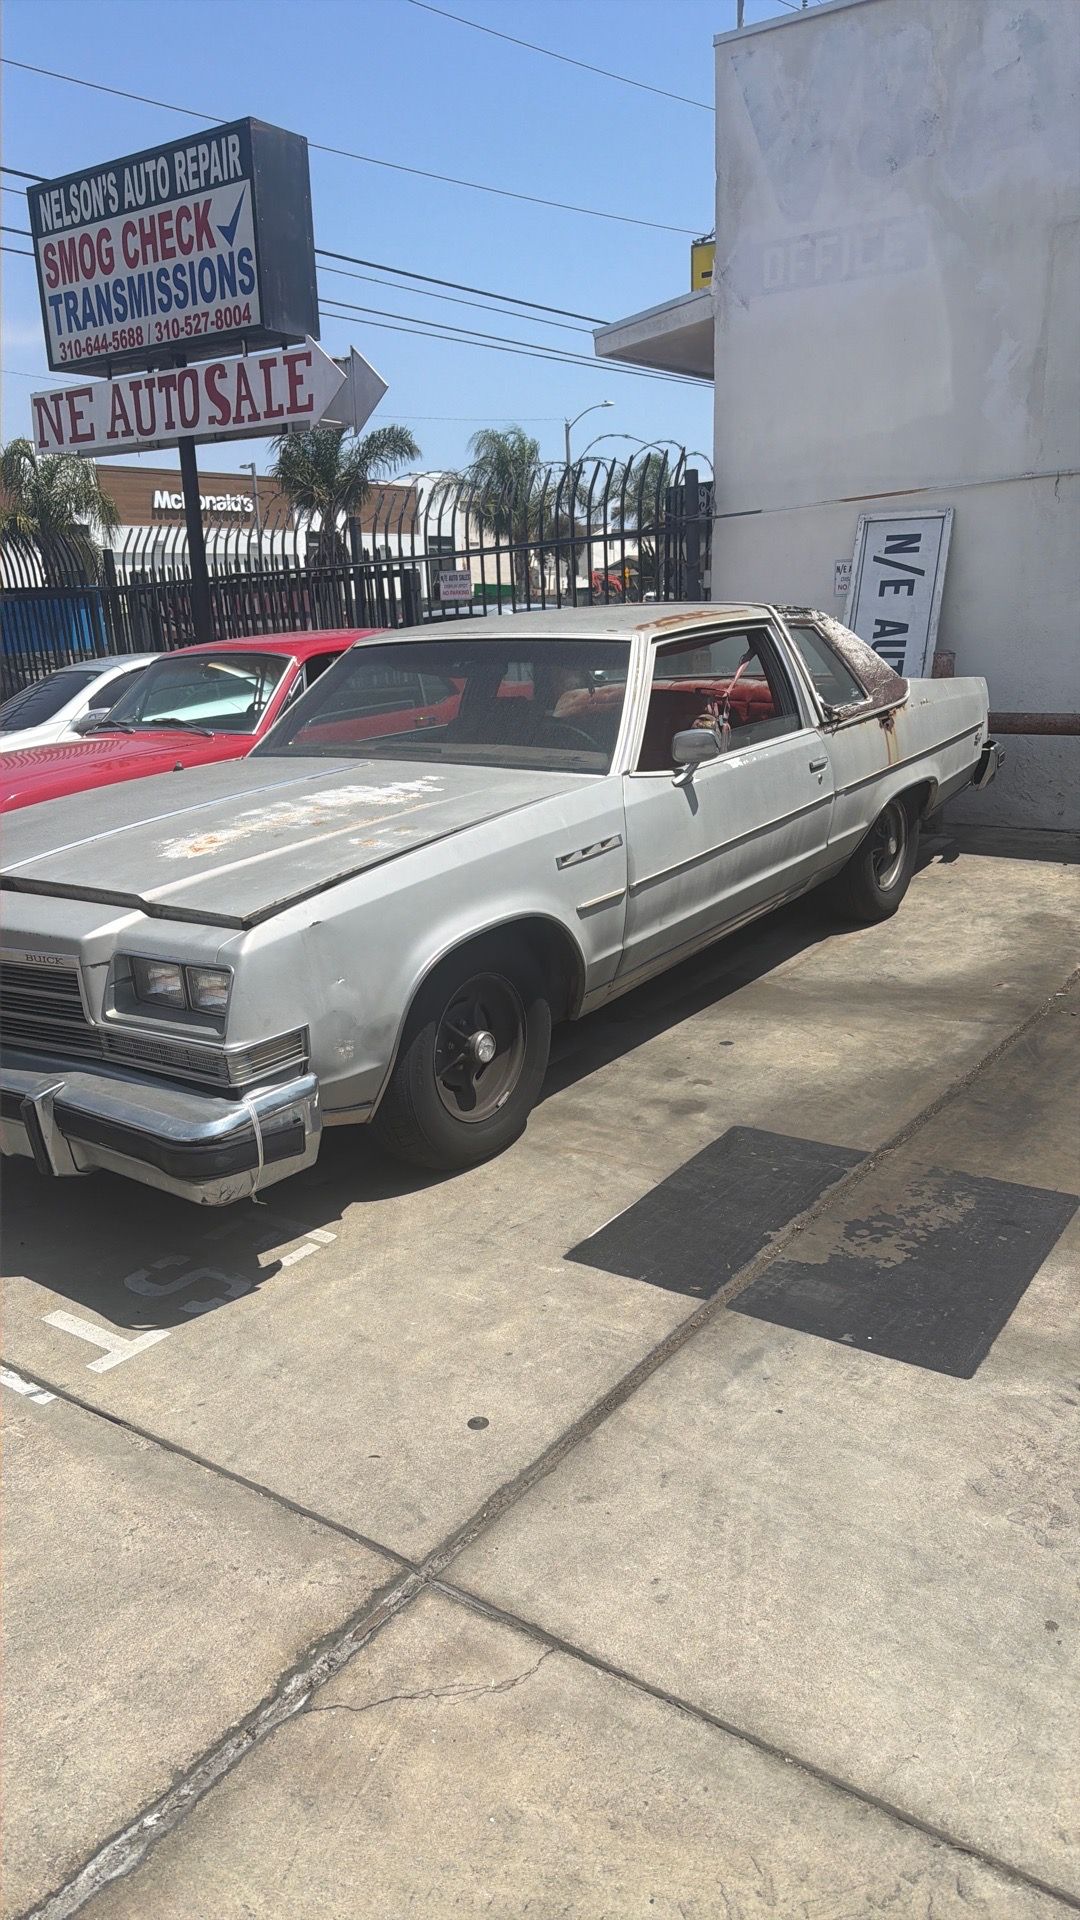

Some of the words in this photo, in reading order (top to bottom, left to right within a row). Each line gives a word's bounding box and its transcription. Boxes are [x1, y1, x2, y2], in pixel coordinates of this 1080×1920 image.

[38, 171, 119, 232] NELSON'S
[124, 156, 170, 209] AUTO
[174, 134, 243, 194] REPAIR
[43, 227, 115, 289] SMOG
[122, 198, 217, 269] CHECK
[48, 247, 256, 336] TRANSMISSIONS
[59, 325, 144, 362] 310-644-5688
[155, 303, 252, 342] 310-527-8004
[33, 387, 95, 449] NE
[153, 490, 254, 512] Mcnald's
[837, 583, 848, 591] NO
[873, 533, 926, 598] N/E
[871, 618, 909, 678] AUT
[25, 953, 65, 966] BUICK
